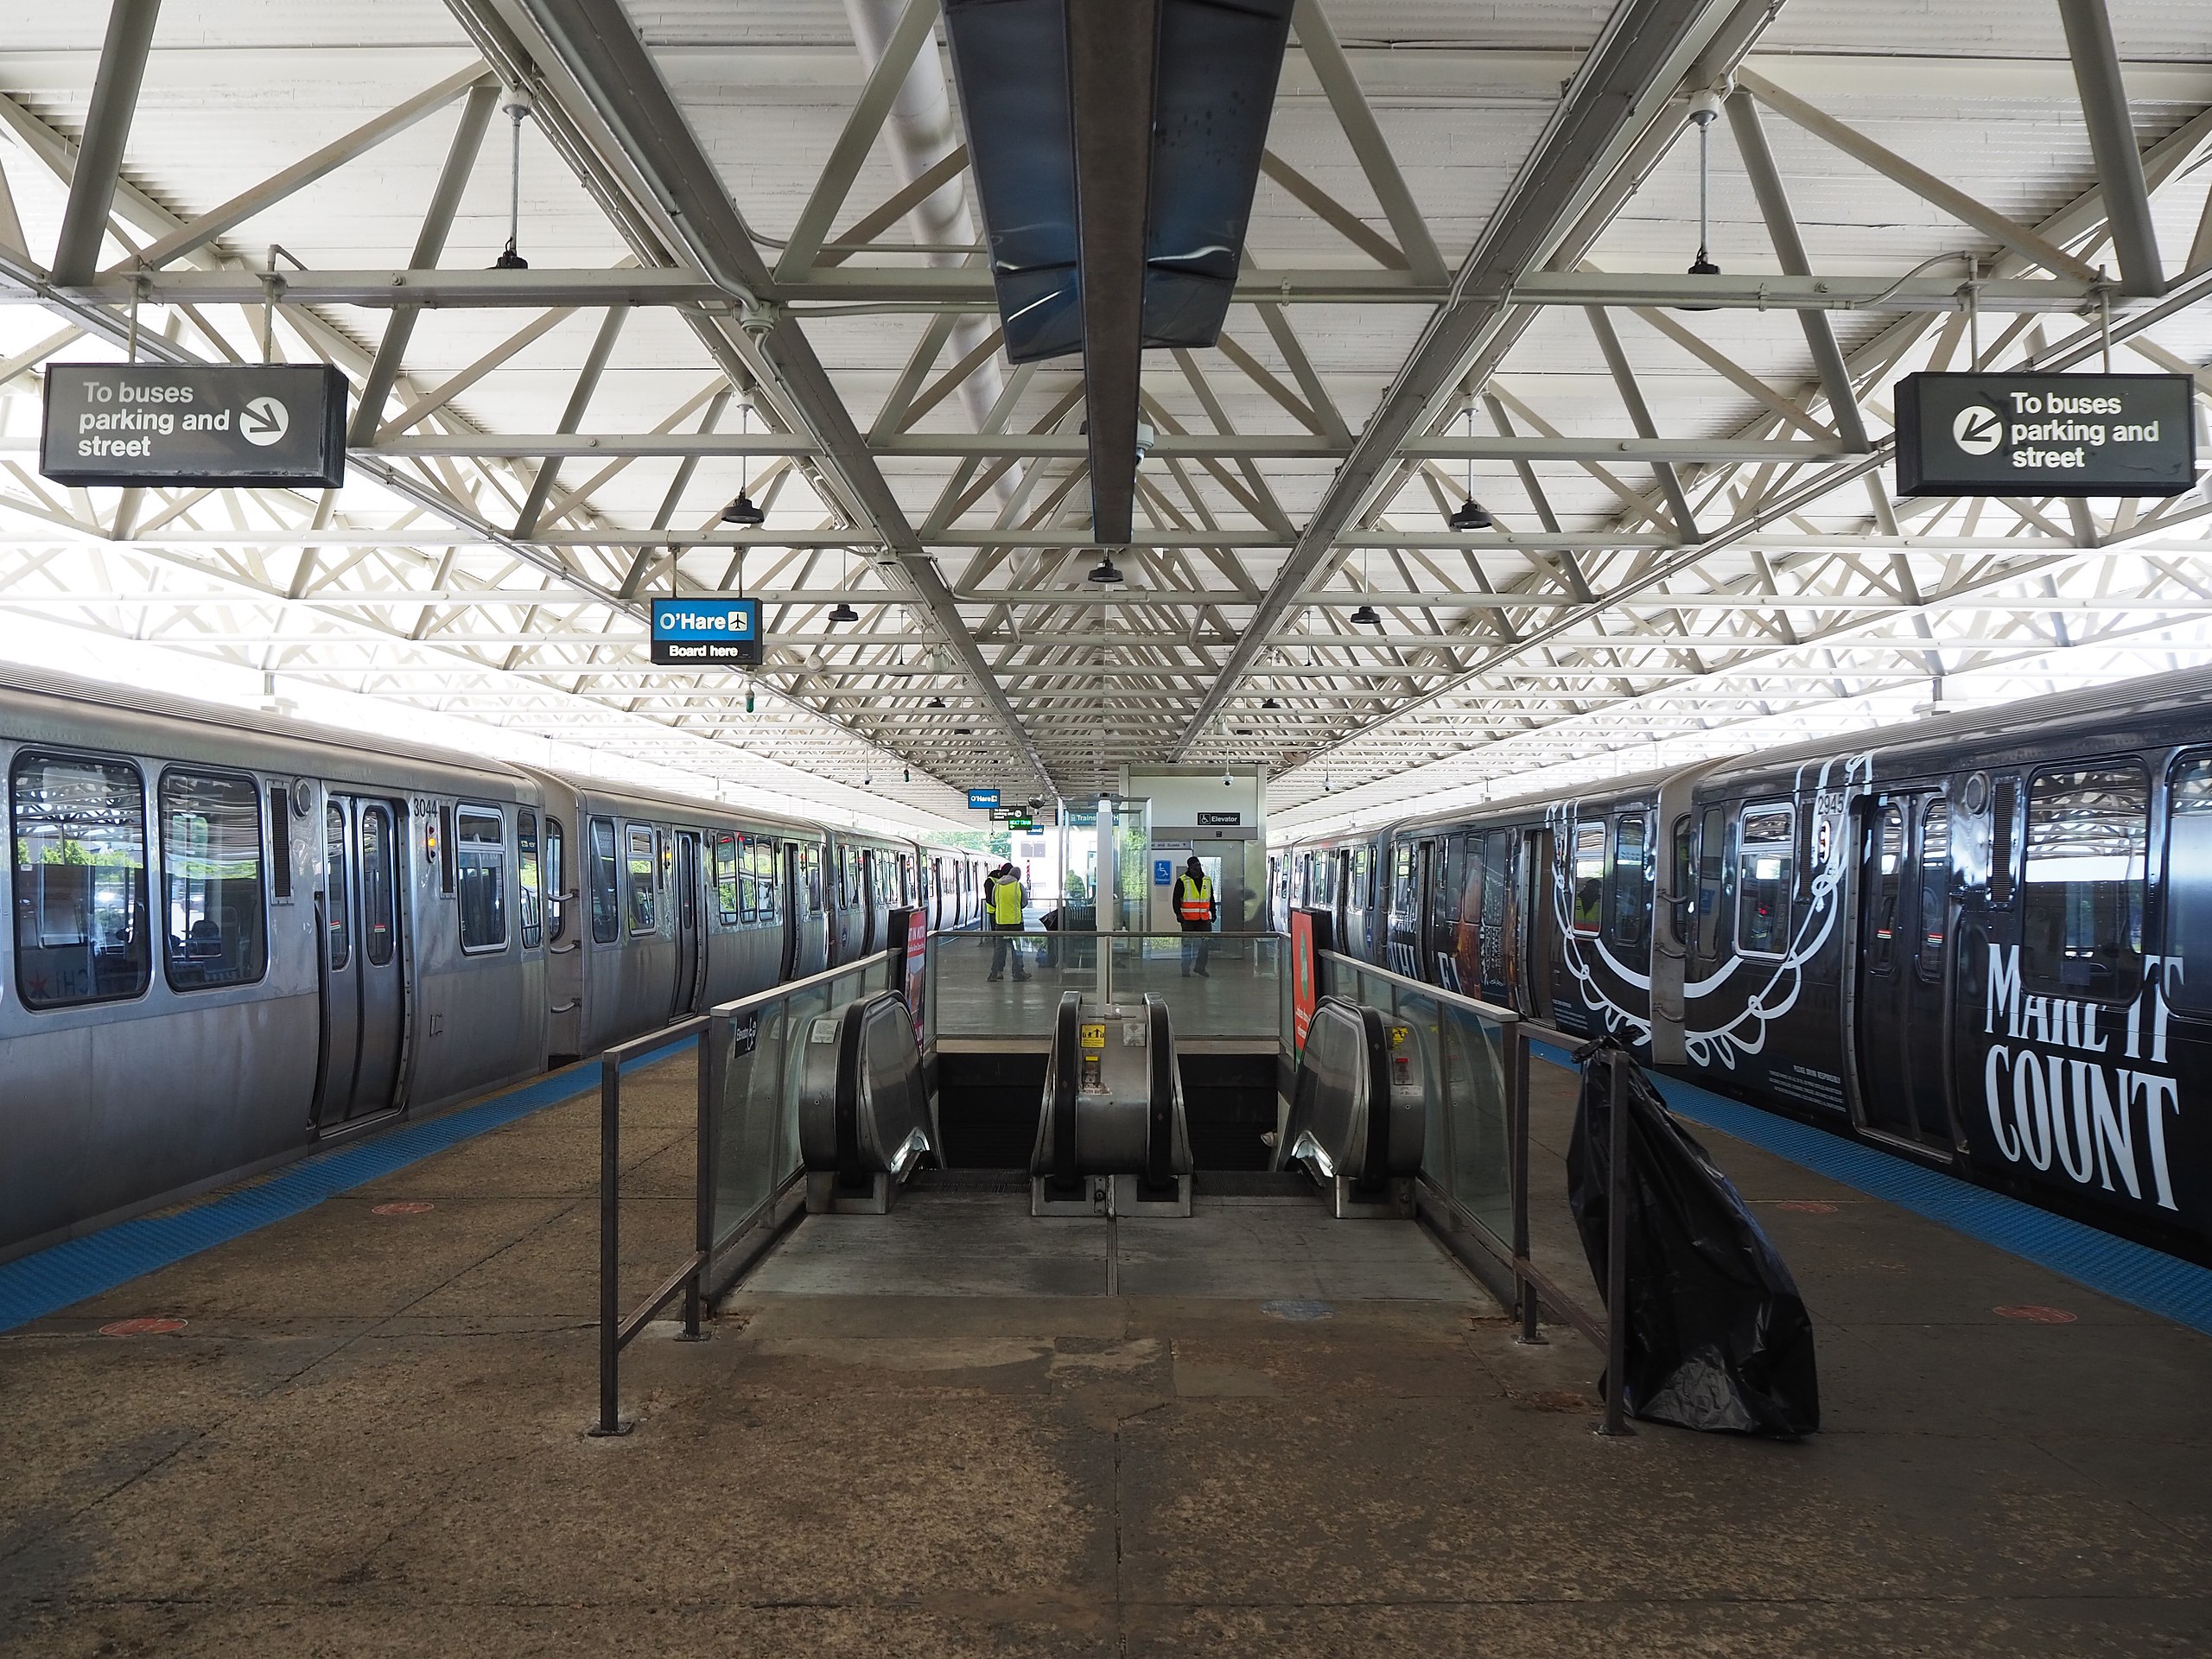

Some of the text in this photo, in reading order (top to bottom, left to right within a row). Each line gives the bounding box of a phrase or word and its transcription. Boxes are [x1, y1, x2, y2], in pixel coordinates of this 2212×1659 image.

[83, 381, 194, 404] To buses
[2010, 391, 2122, 415] To buses
[79, 408, 231, 435] parking and
[2011, 419, 2159, 446] parking and
[78, 435, 151, 457] street
[2012, 446, 2085, 468] street
[659, 612, 727, 630] O'Hare
[669, 645, 707, 657] Board
[709, 645, 739, 657] here
[413, 798, 438, 817] 3044
[1817, 794, 1844, 815] 2945
[1985, 1044, 2180, 1211] COUNT
